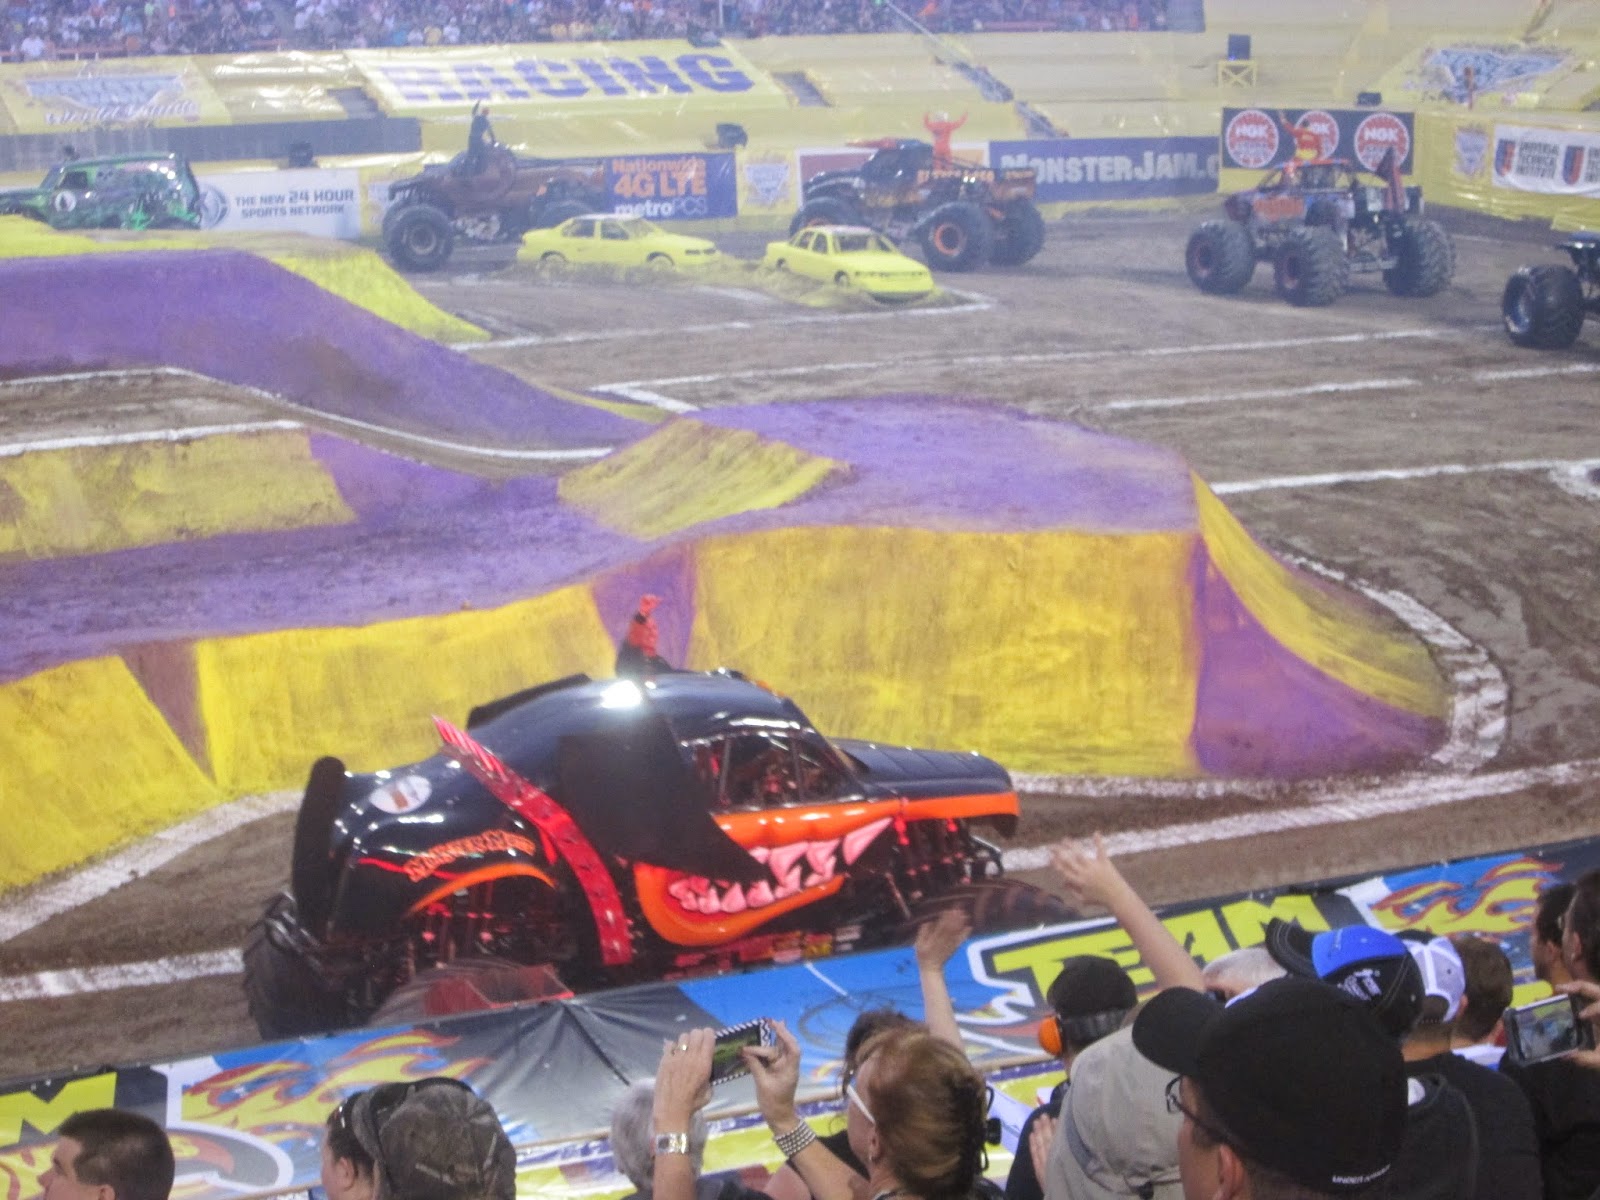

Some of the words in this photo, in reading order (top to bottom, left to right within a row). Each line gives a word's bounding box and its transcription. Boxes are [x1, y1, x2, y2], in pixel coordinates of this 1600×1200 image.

[380, 54, 755, 99] RACING
[1364, 127, 1399, 141] NGK
[612, 156, 706, 174] Nationwide
[614, 172, 656, 198] 4G
[659, 169, 707, 197] LTE
[235, 196, 257, 206] THE
[259, 194, 285, 205] NEW
[288, 189, 310, 204] 24
[313, 188, 354, 202] HOUR
[241, 206, 287, 218] SPORTS
[289, 203, 345, 215] NETWORK
